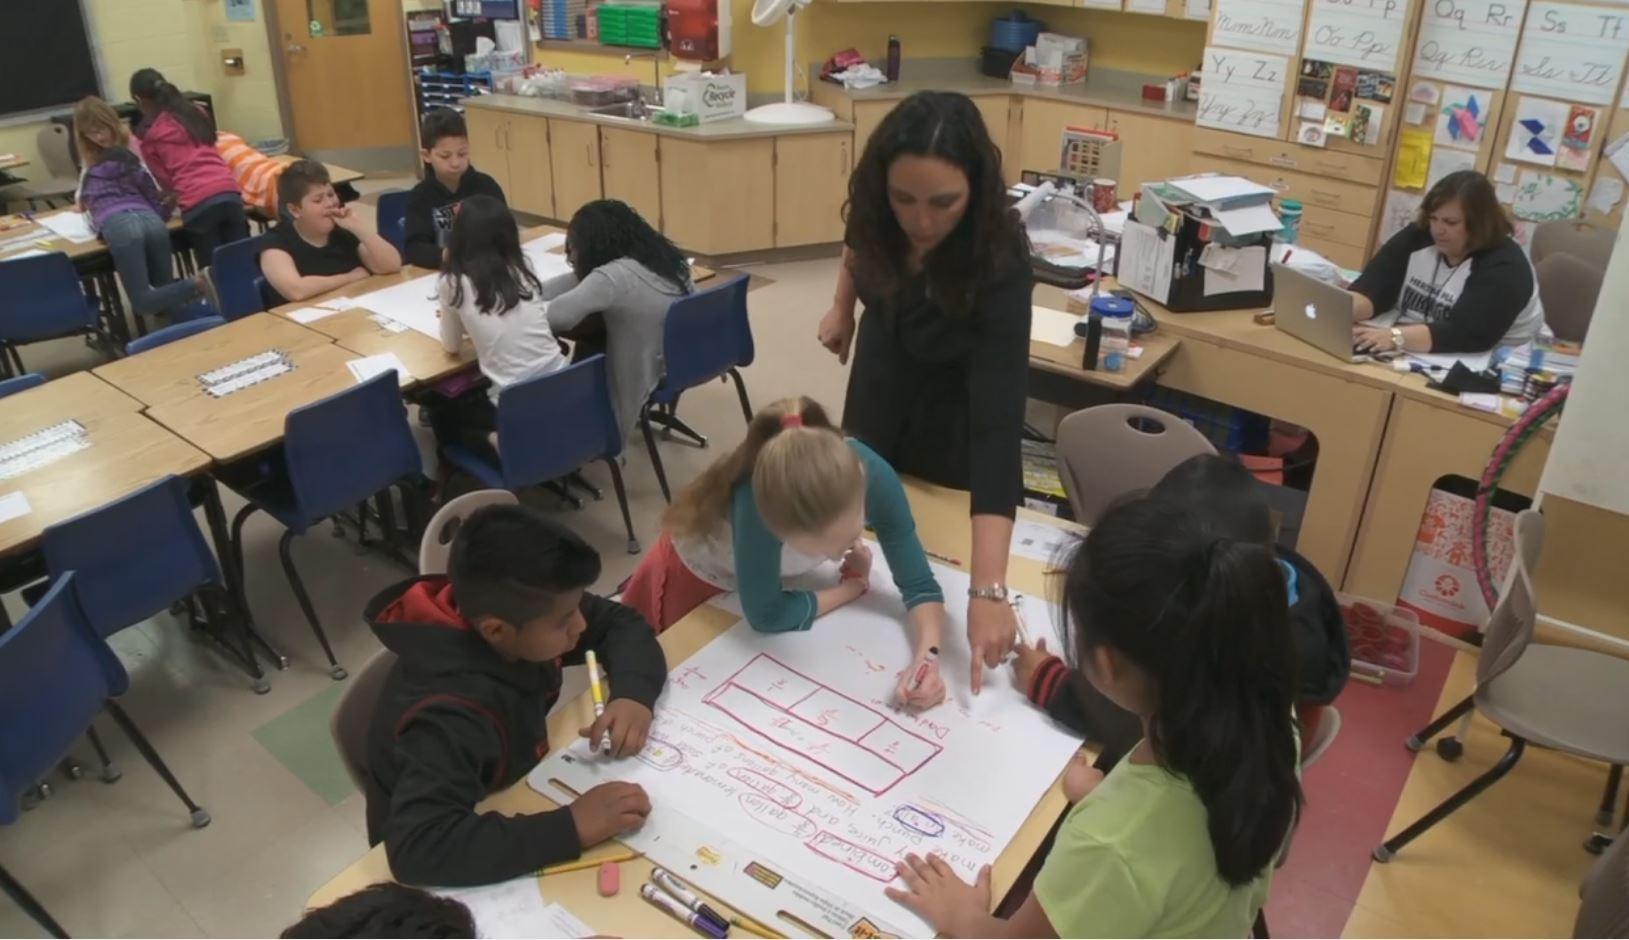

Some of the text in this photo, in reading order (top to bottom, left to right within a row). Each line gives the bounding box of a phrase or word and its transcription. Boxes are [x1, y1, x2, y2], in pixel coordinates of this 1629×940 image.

[1486, 3, 1513, 26] Rr
[1541, 9, 1567, 33] Ss
[1212, 54, 1277, 83] Yy Zz
[818, 832, 893, 875] ombined
